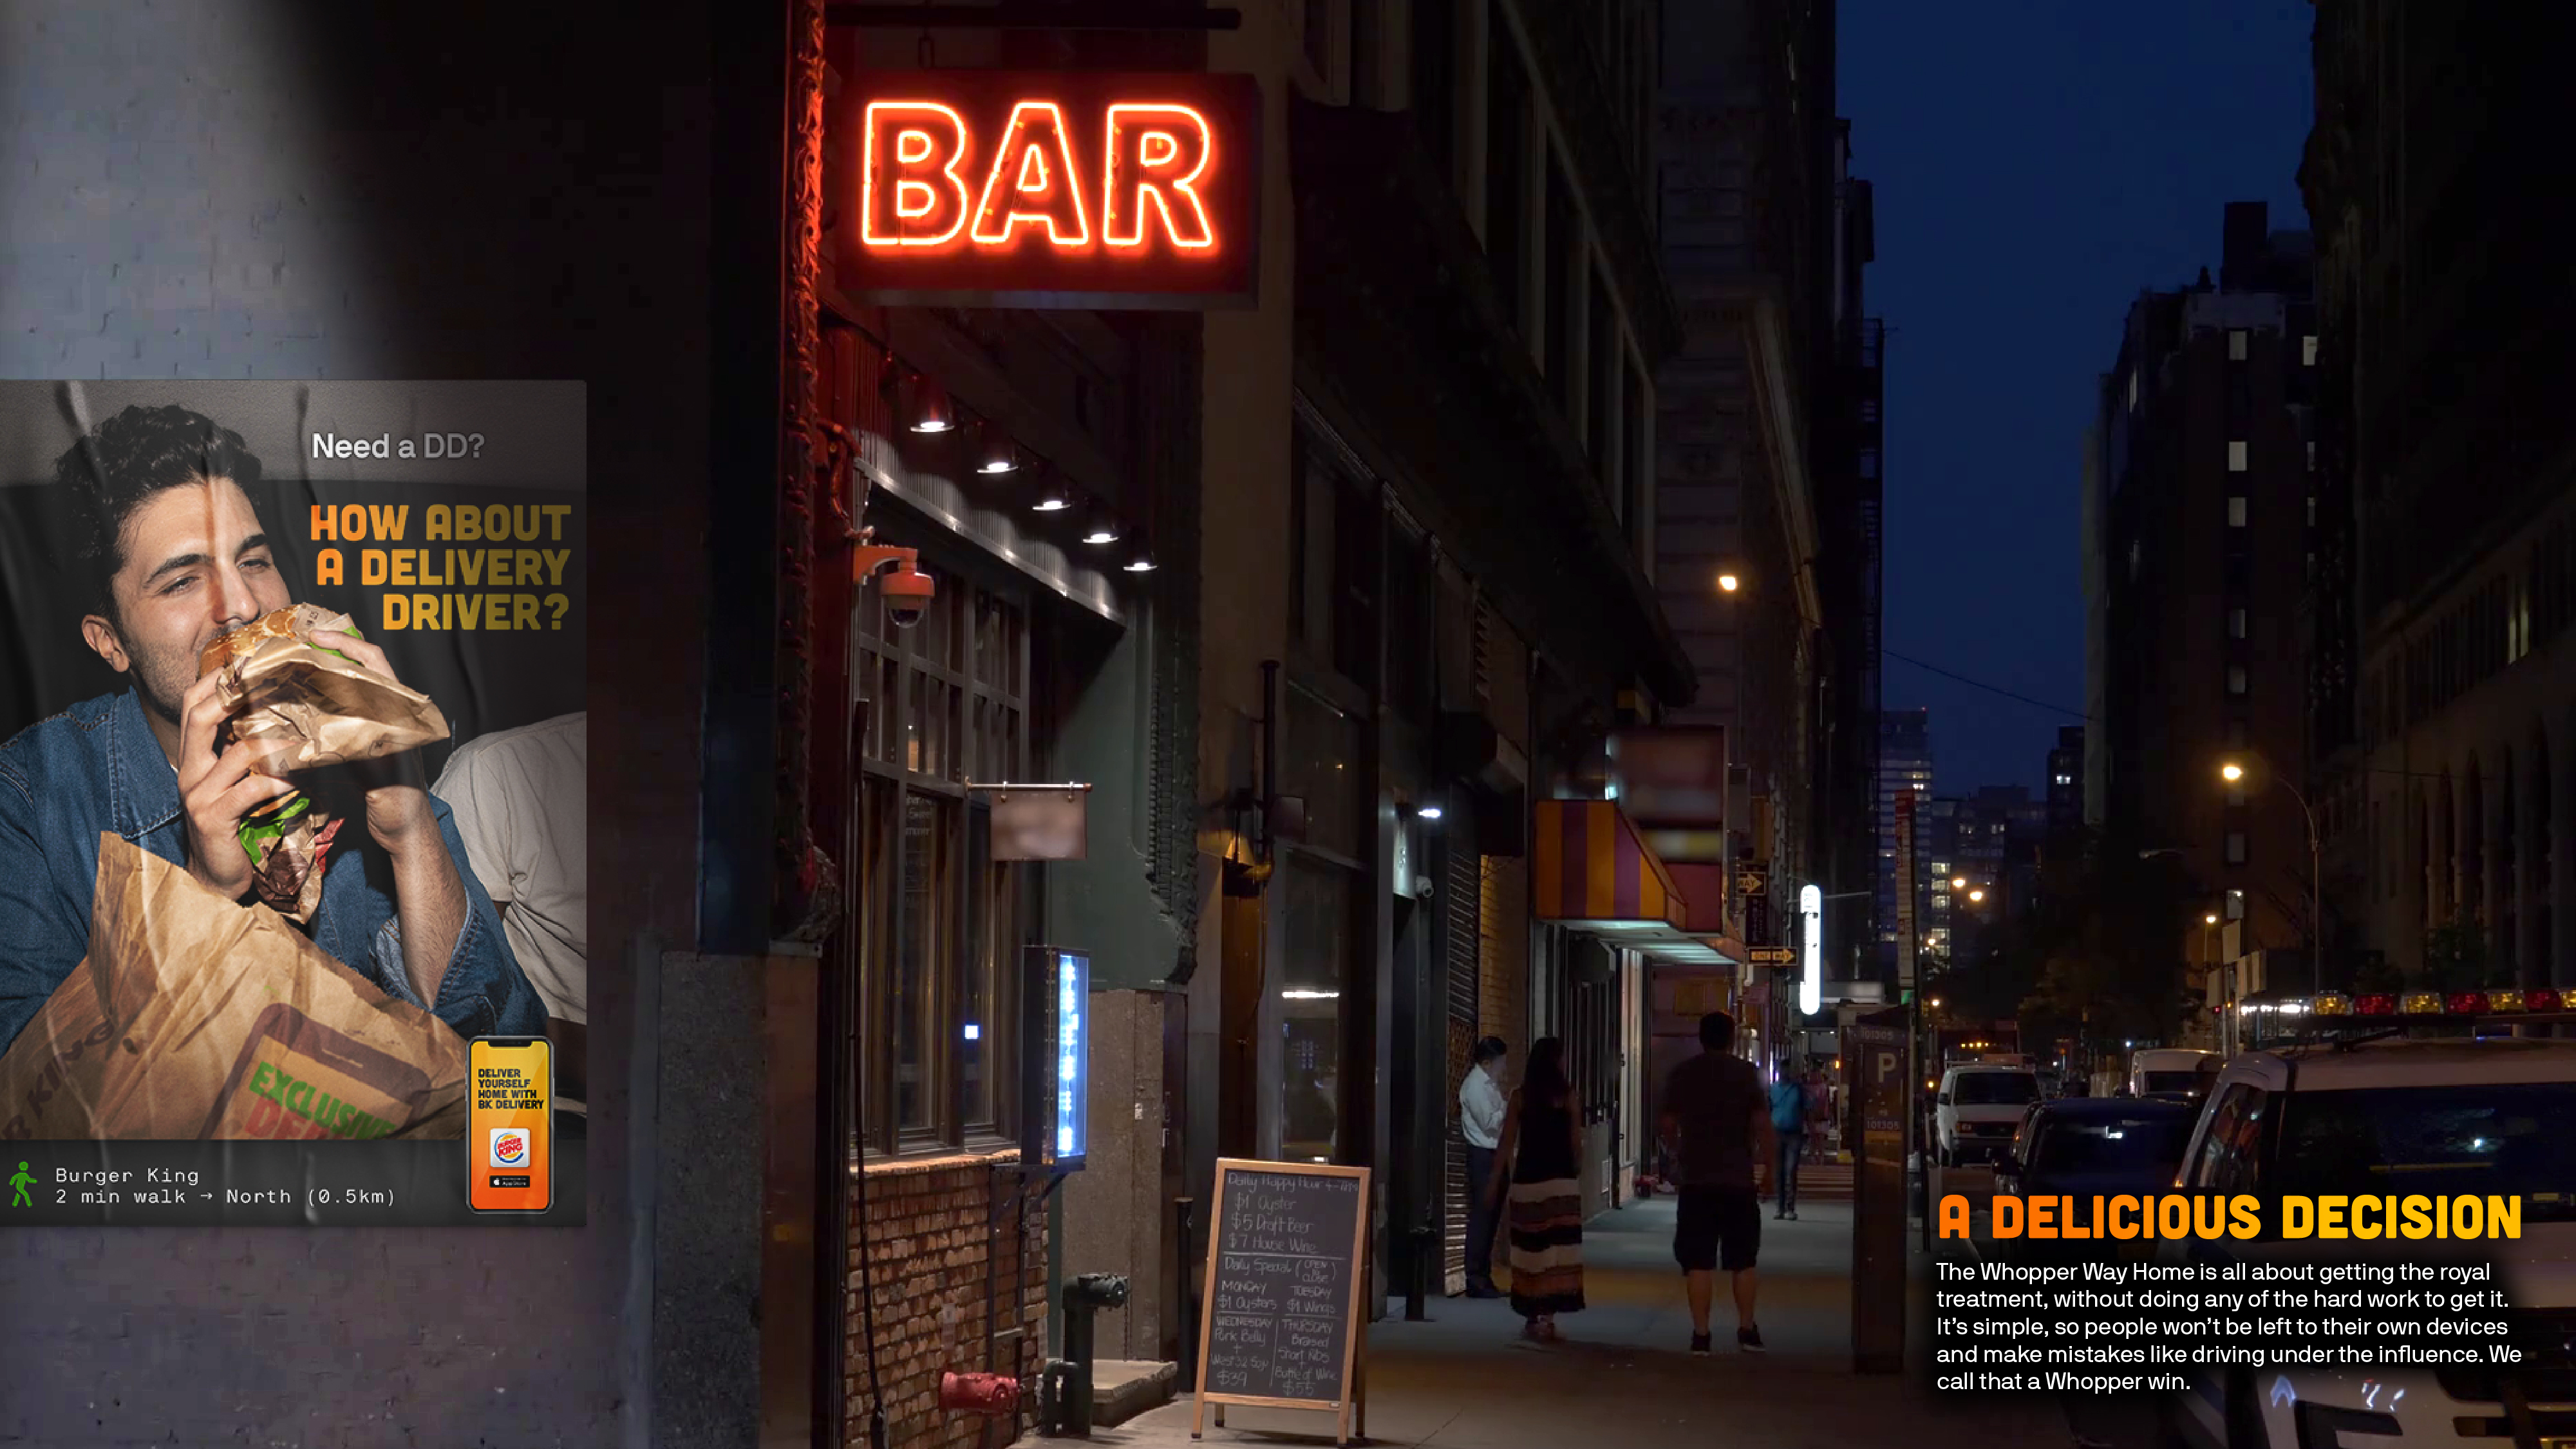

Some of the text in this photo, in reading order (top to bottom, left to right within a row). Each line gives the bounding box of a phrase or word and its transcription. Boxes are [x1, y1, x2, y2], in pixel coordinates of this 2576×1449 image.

[862, 100, 1217, 248] BAR
[314, 433, 485, 459] Need a DD?
[311, 504, 571, 541] HOW ABOUT
[317, 548, 571, 586] A DELIVERY
[383, 594, 569, 630] DRIVER?
[478, 1069, 521, 1078] DELIVER
[1878, 1052, 1896, 1083] P
[478, 1079, 531, 1089] YOURSELF
[478, 1090, 537, 1099] HOME WITH
[478, 1100, 545, 1110] BK DELIVERY
[56, 1168, 198, 1185] Burger King
[1228, 1172, 1257, 1193] Daily
[1262, 1175, 1296, 1193] Happy
[1298, 1175, 1324, 1190] Hour
[56, 1189, 393, 1207] 2 min walk North (0.5km)
[1231, 1211, 1314, 1237] $5 Draft Beer
[1228, 1231, 1248, 1249] $7
[1252, 1233, 1285, 1252] House
[1225, 1256, 1250, 1276] Daily
